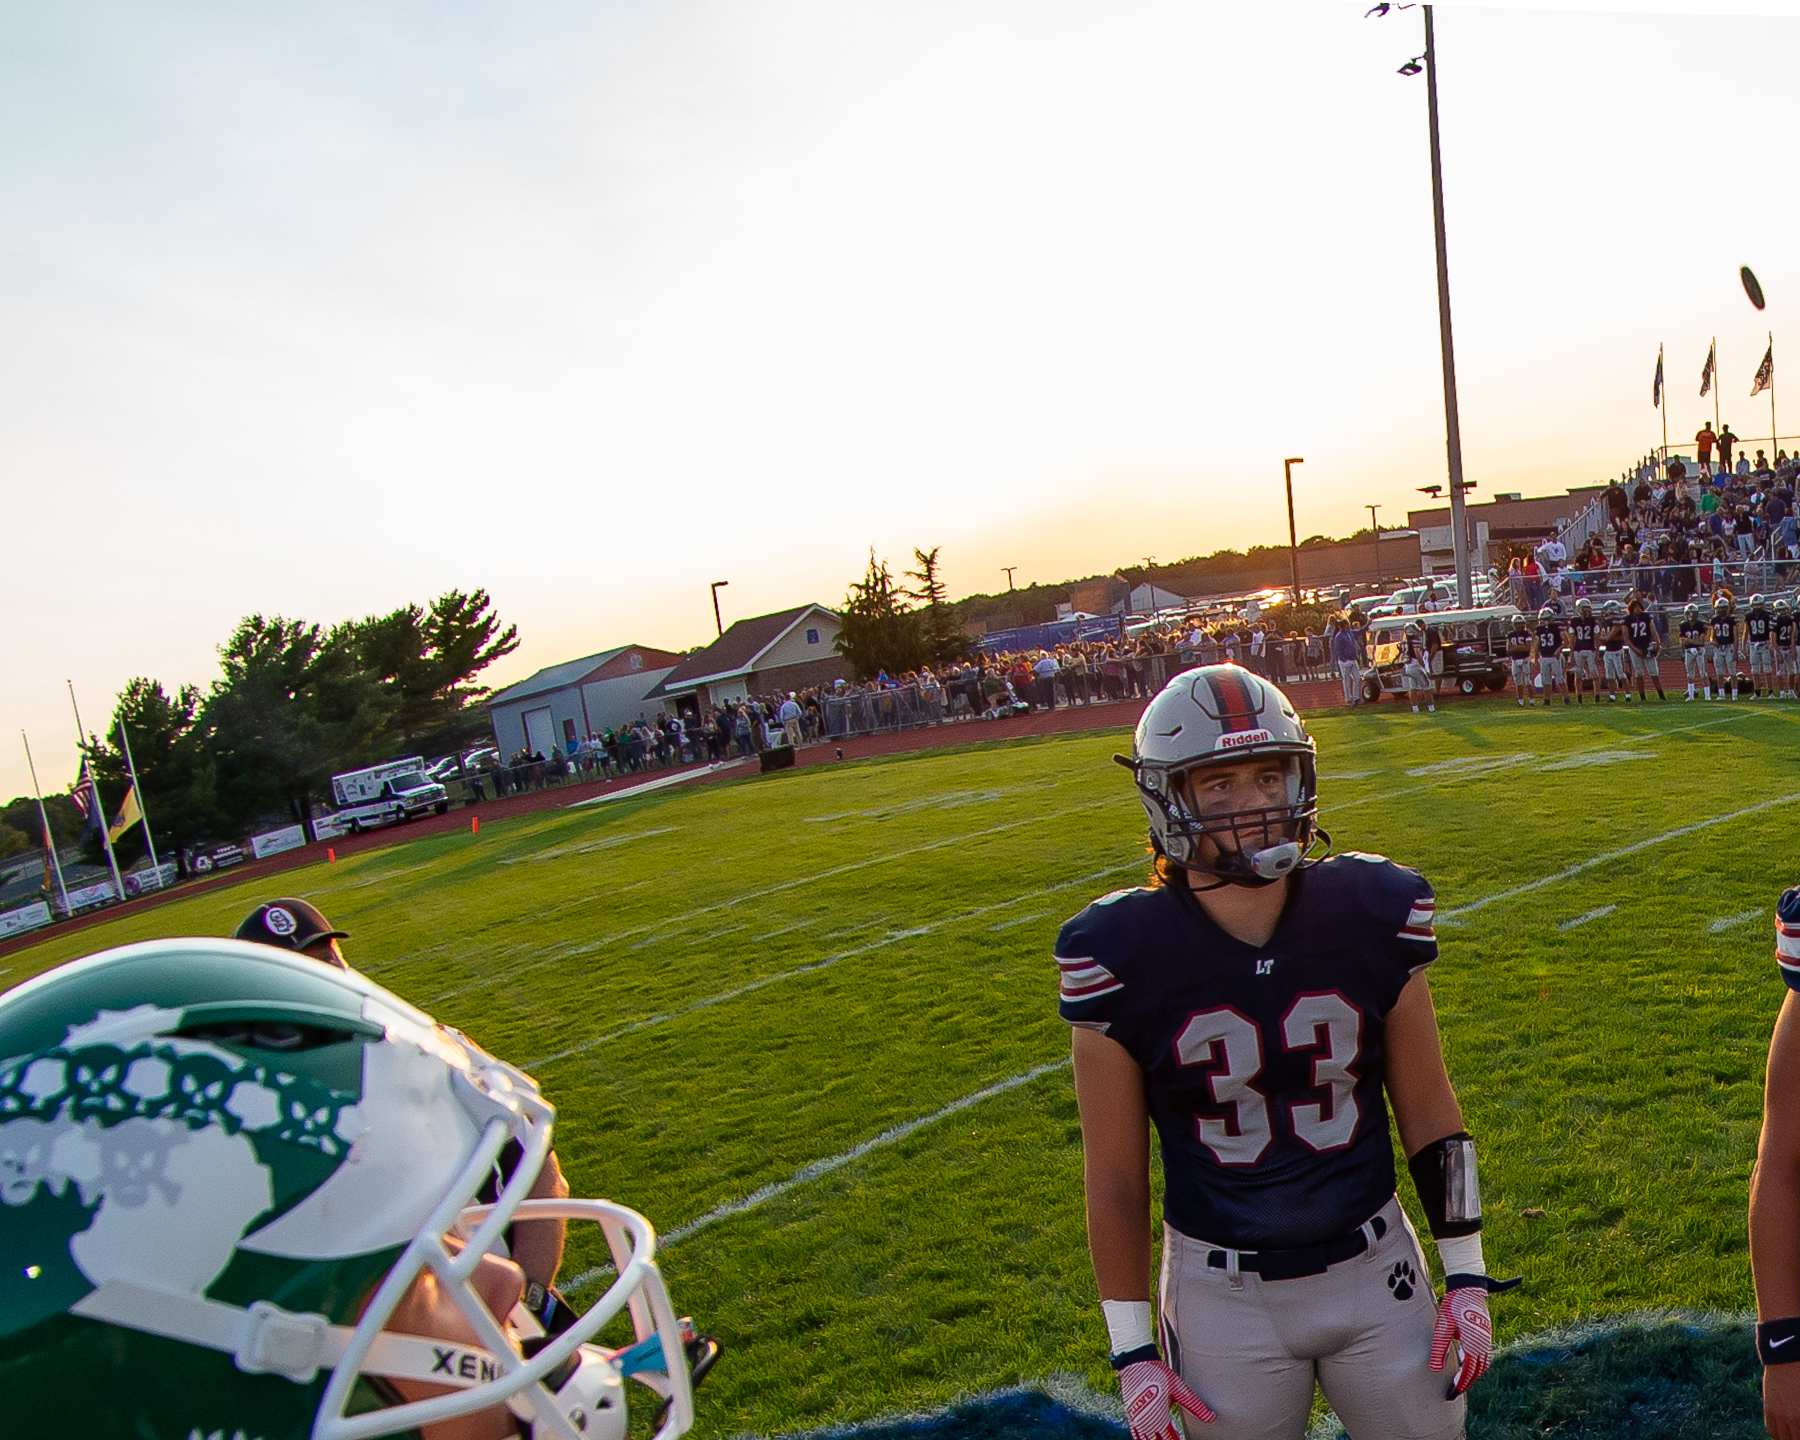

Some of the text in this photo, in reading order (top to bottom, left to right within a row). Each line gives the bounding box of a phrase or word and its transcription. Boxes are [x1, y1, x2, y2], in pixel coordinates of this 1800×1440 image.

[1631, 621, 1648, 638] 72
[1540, 632, 1555, 648] 53
[1222, 732, 1269, 748] Riddell
[1255, 958, 1275, 976] LT
[1172, 988, 1364, 1168] 33
